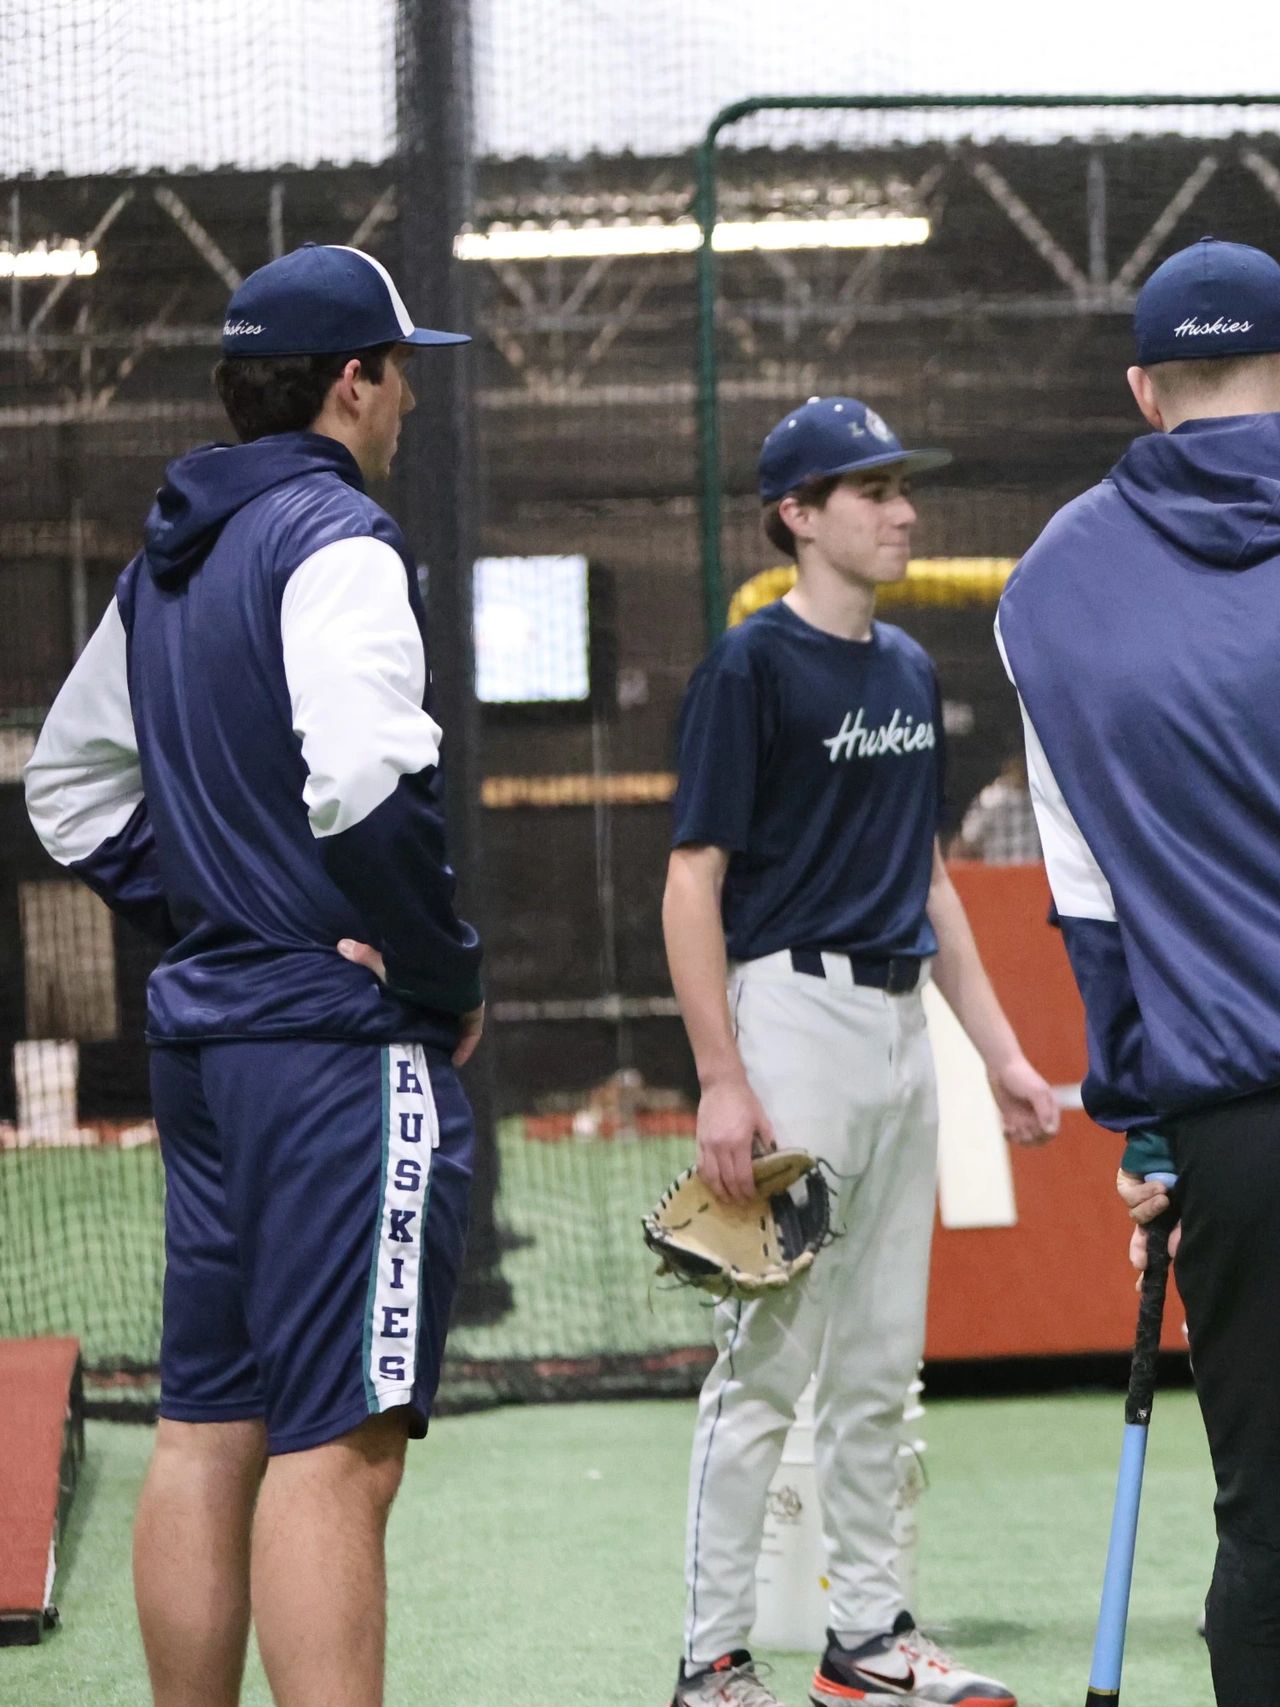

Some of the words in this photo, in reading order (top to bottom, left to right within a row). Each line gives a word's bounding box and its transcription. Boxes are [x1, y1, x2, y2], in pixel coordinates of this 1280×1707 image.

[1173, 316, 1255, 338] Huskies
[822, 706, 936, 763] Huskies
[378, 1060, 425, 1382] HUSKIES
